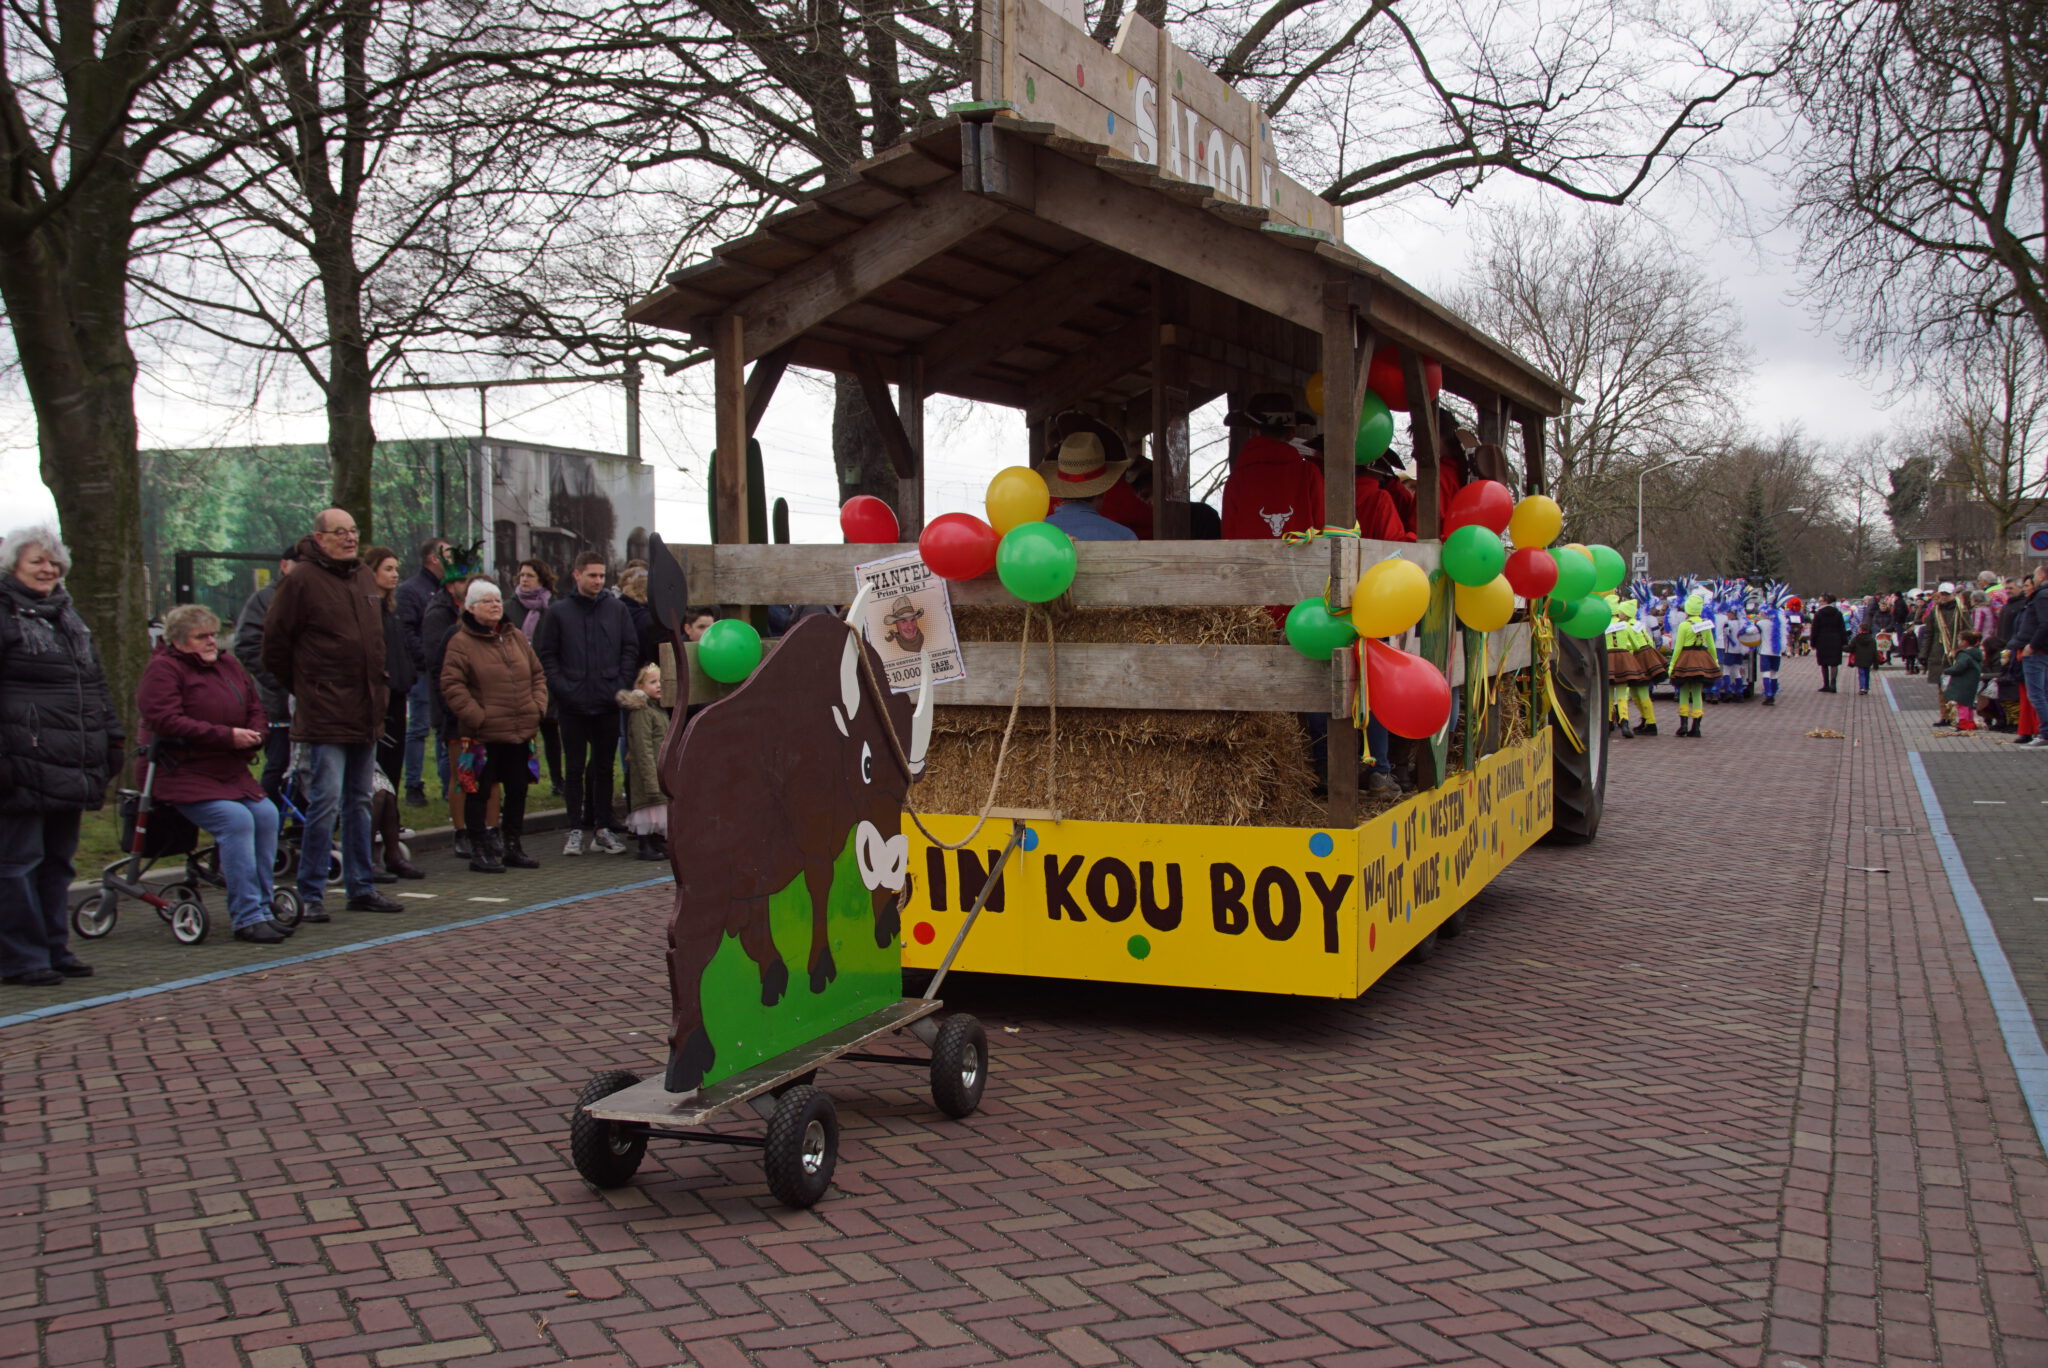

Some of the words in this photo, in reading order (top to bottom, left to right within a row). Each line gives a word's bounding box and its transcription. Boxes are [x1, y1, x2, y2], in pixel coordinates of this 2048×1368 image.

[1133, 75, 1272, 208] SALOON
[866, 563, 932, 591] WANTED
[876, 589, 898, 599] Prins
[899, 584, 921, 593] Thijs
[930, 659, 950, 669] CASH
[1363, 854, 1385, 912] WAI
[1404, 805, 1417, 861] UT
[1429, 788, 1464, 839] WESTEN
[1477, 773, 1491, 816] ONS
[1496, 757, 1525, 804] CARNAVAL
[1387, 862, 1403, 924] OIT
[1413, 851, 1440, 910] WILDE
[1454, 815, 1478, 888] VULEN
[1525, 790, 1533, 833] UT
[1537, 778, 1552, 821] BESTE
[904, 846, 1006, 914] IN
[1043, 853, 1183, 932] KOU
[1209, 861, 1355, 954] BOY
